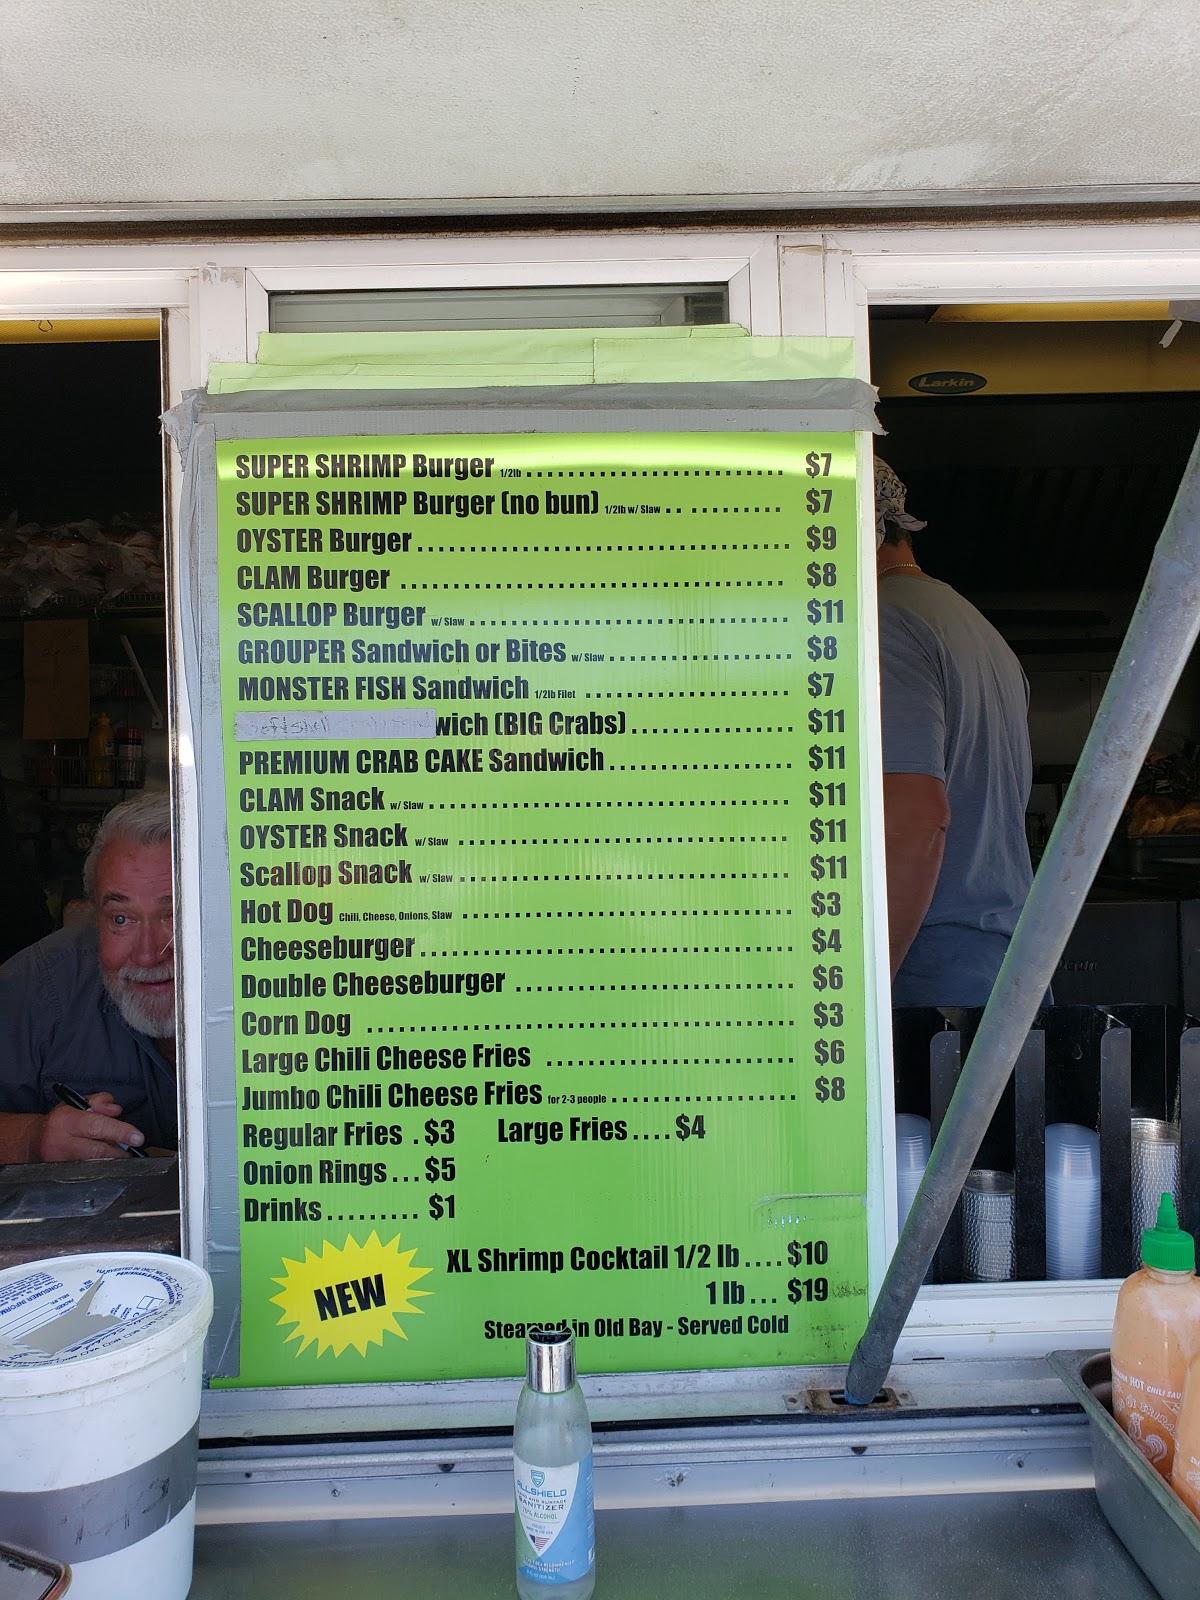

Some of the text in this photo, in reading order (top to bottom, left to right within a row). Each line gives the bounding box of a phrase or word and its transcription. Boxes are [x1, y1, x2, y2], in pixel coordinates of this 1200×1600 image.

[918, 376, 976, 388] Larkin
[236, 452, 832, 481] SUPER SHRIMP Burger 1/2lb $7
[236, 488, 832, 517] SUPER SHRIMP Burger (no bun) 1/2lb w/ Slaw $7
[237, 525, 836, 555] OYSTER Burger $9
[237, 562, 836, 592] CLAM Burger $8
[237, 598, 843, 629] SCALLOP Burger w/ Slaw $11
[238, 635, 837, 664] GROUPER Sandwich or Bites w/ Slaw $8
[239, 671, 834, 701] MONSTER FISH Sandwich 1/2lb Filet $7
[495, 712, 542, 736] (BIG
[550, 711, 626, 735] Crabs)
[808, 708, 844, 735] $11
[240, 744, 845, 775] PREMIUM CRAB CAKE Sandwich $11
[240, 781, 845, 812] CLAM Snack w/ Slaw $11
[241, 818, 846, 849] OYSTER Snack w/ Slaw $11
[240, 854, 847, 887] Scallop Snack w/ Slaw $11
[241, 900, 281, 924] Hot
[288, 899, 332, 924] Dog
[432, 911, 452, 920] Slaw
[811, 891, 840, 918] $3
[241, 928, 841, 961] Cheeseburger $4
[242, 964, 843, 998] Double Cheeseburger $6
[242, 1002, 843, 1036] Corn Dog $3
[242, 1039, 844, 1076] Large Chili Cheese Fries $6
[242, 1076, 845, 1110] Jumbo Chili Cheese Fries for 2-3 people $8
[244, 1118, 454, 1150] Regular Fries $3
[498, 1114, 705, 1144] Large Fries $4
[244, 1156, 455, 1186] Onion Rings $5
[244, 1193, 454, 1222] Drinks $1
[447, 1240, 828, 1273] XL Shrimp Cocktail 1/2 lb $10
[313, 1273, 386, 1322] NEW
[706, 1282, 715, 1304] 1
[722, 1281, 744, 1304] lb
[788, 1277, 828, 1304] $19
[572, 1319, 589, 1337] in
[595, 1318, 623, 1337] Old
[630, 1317, 662, 1338] Bay
[678, 1316, 742, 1335] Served
[748, 1315, 788, 1334] Cold
[1130, 1376, 1144, 1390] HOT
[1166, 1392, 1184, 1400] SAU
[519, 1496, 564, 1511] SANITIZER
